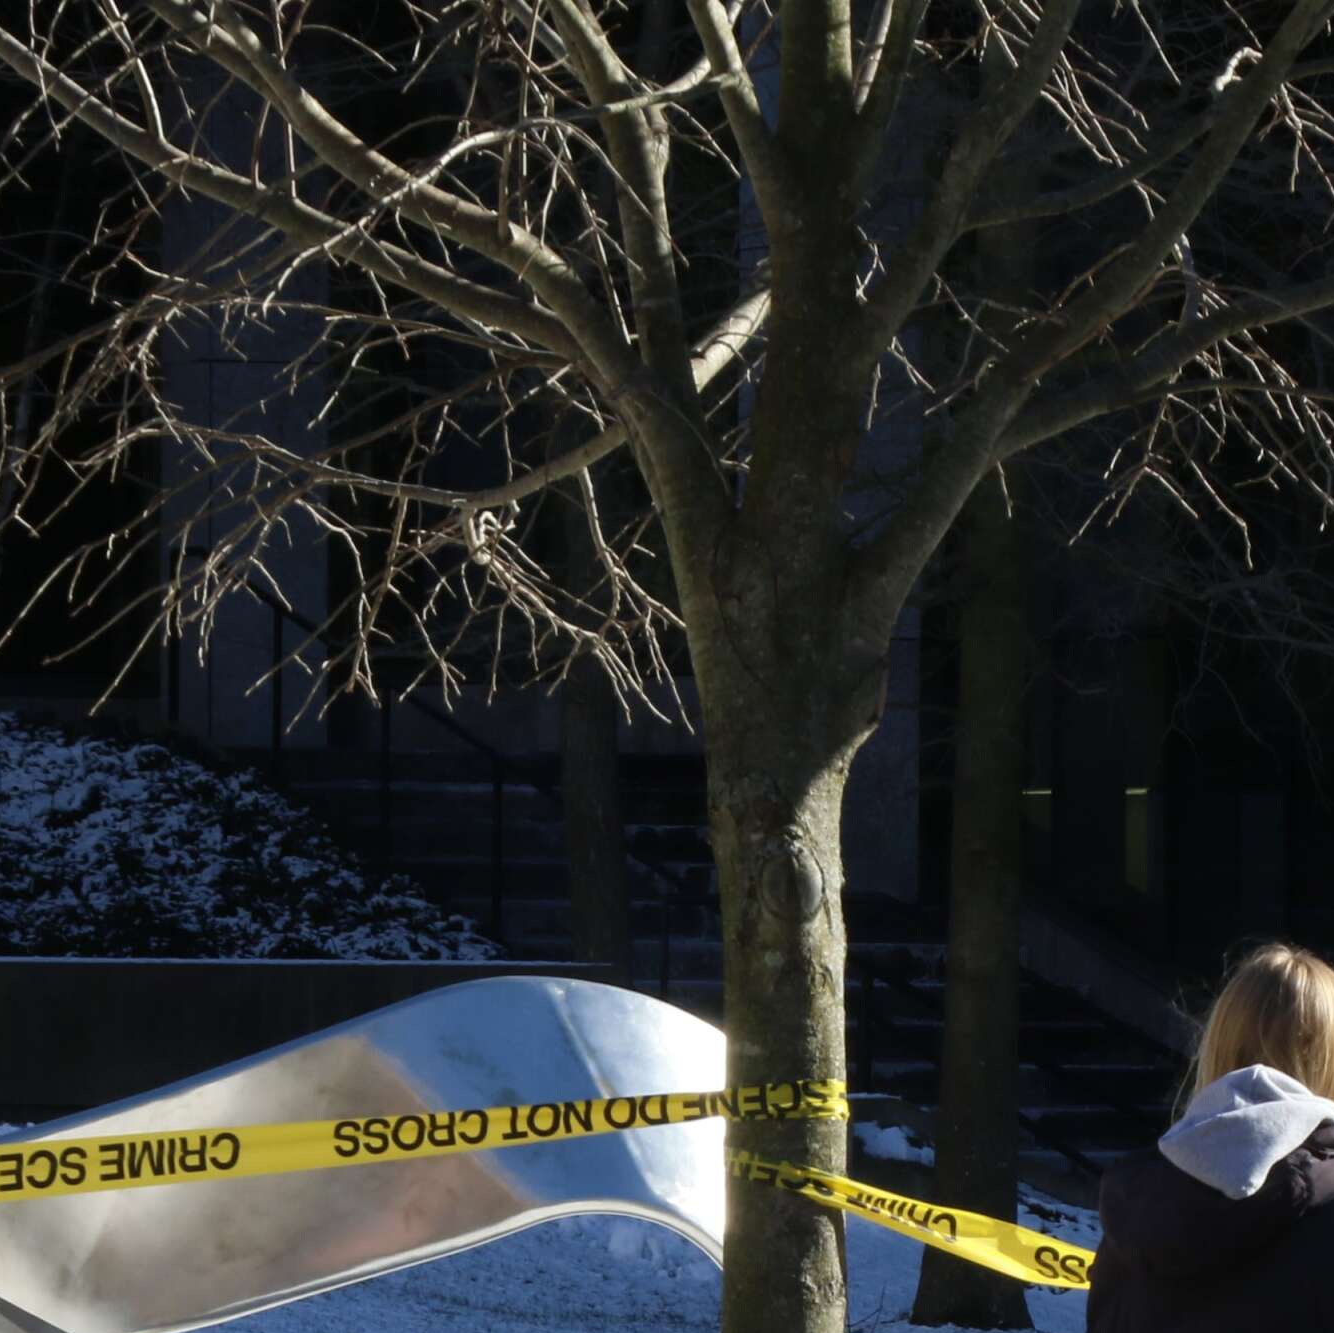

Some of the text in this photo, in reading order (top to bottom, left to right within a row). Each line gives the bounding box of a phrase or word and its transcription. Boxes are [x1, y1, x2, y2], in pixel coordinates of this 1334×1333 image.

[501, 1099, 594, 1141] NOT
[603, 1094, 669, 1126] DO
[333, 1109, 490, 1158] CROSS
[98, 1132, 241, 1182] CRIME
